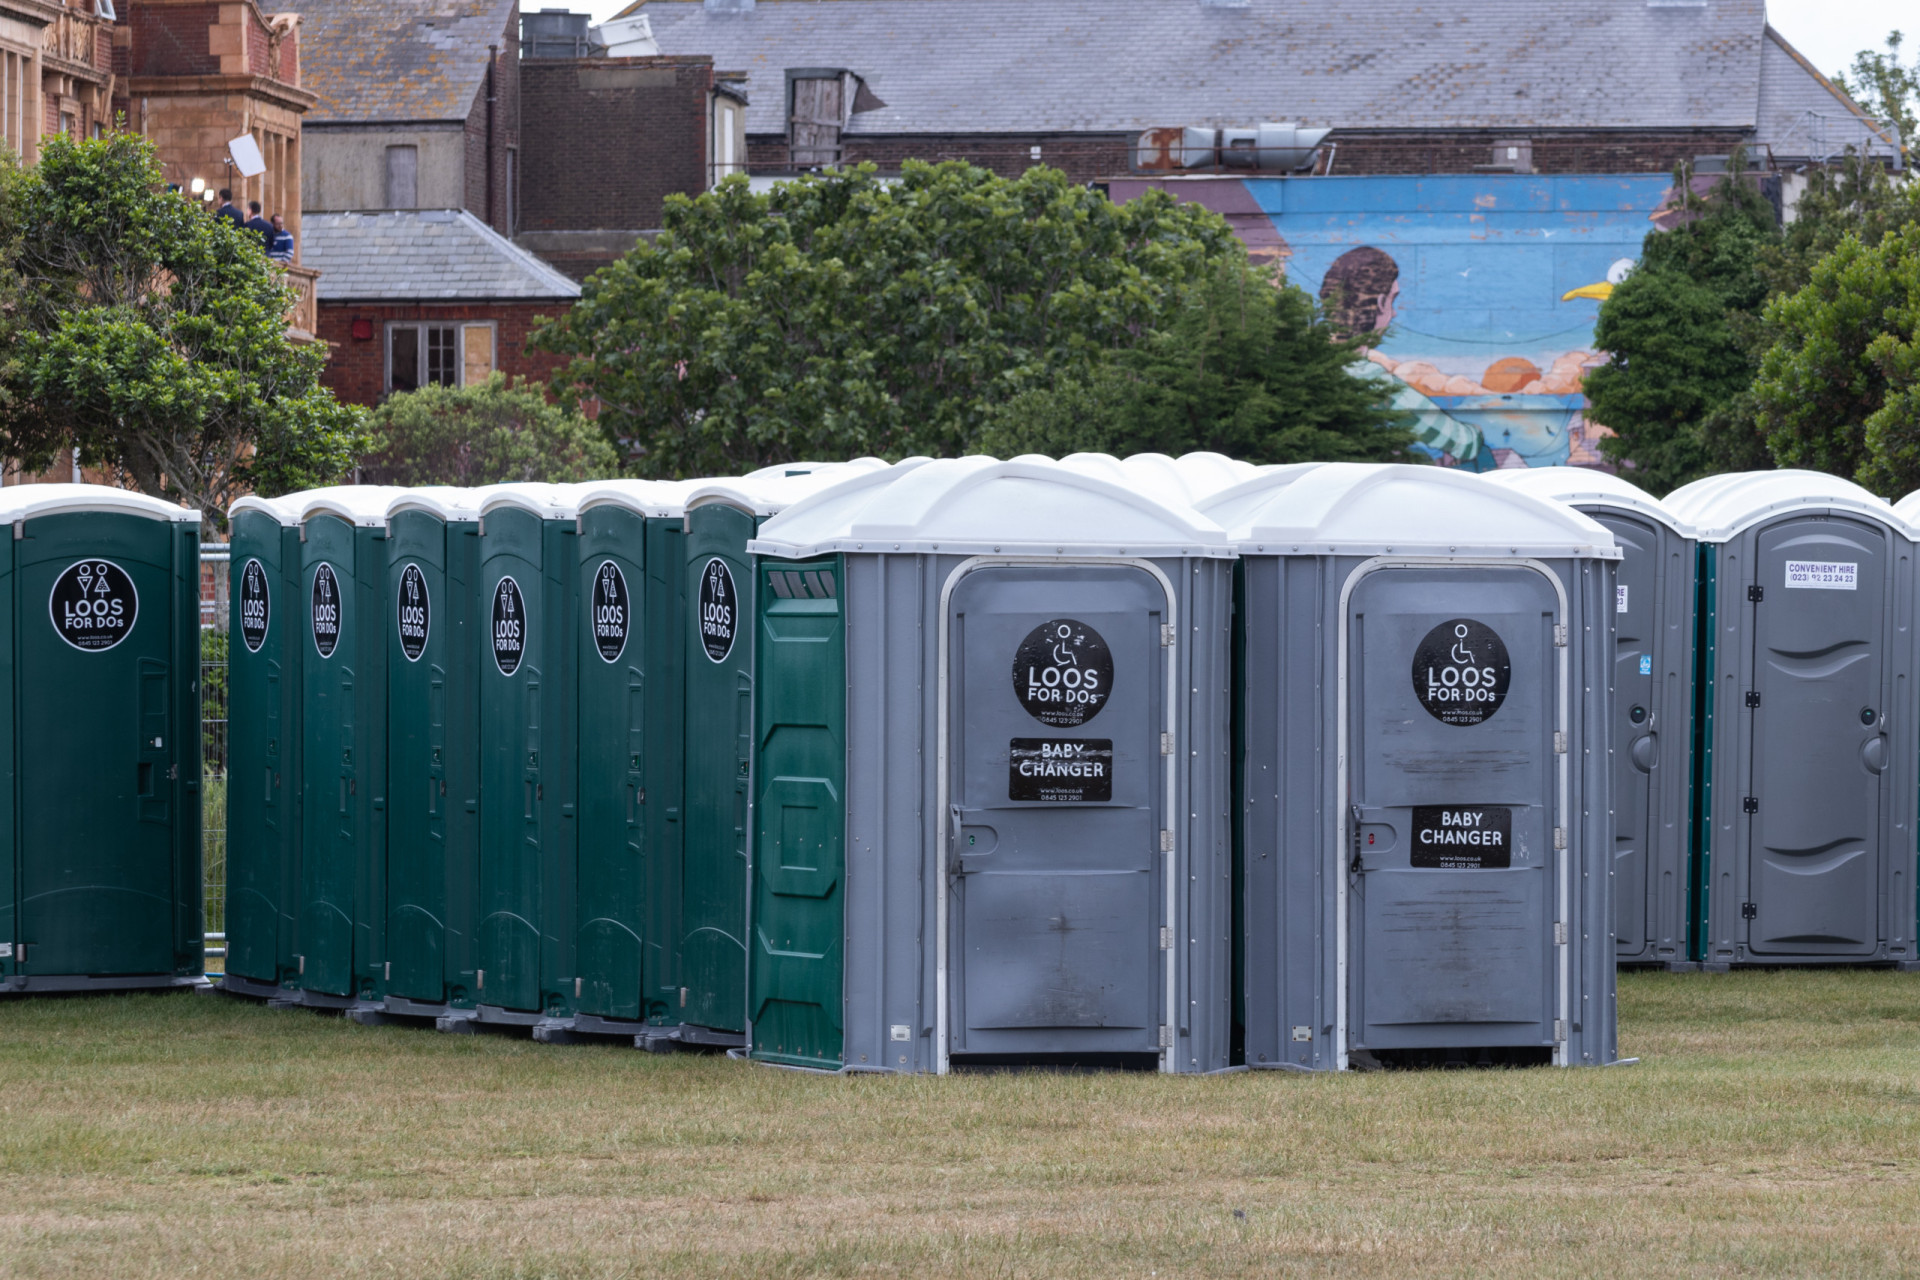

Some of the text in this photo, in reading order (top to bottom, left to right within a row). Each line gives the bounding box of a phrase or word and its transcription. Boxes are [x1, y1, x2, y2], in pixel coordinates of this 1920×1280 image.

[1789, 564, 1855, 574] CONVENIENT HIRE
[1845, 575, 1854, 583] 23
[65, 599, 123, 617] LOOS
[244, 600, 264, 617] LOOS
[315, 605, 336, 621] LOOS
[402, 606, 424, 625] LOOS
[597, 605, 623, 624] LOOS
[704, 602, 730, 625] LOOS
[65, 617, 93, 629] FOR
[244, 617, 253, 628] FOR
[315, 622, 325, 633] FOR
[402, 624, 412, 636] FOR
[496, 620, 519, 638] LOOS
[704, 621, 716, 634] FOR
[597, 624, 609, 637] FOR
[496, 639, 507, 651] FOR
[1028, 666, 1098, 689] LOOS
[1428, 666, 1496, 687] LOOS
[1028, 687, 1060, 702] FOR
[1428, 687, 1460, 702] FOR
[1042, 743, 1084, 758] BABY
[1020, 762, 1103, 777] CHANGER
[1442, 811, 1482, 826] BABY
[1420, 829, 1502, 845] CHANGER
